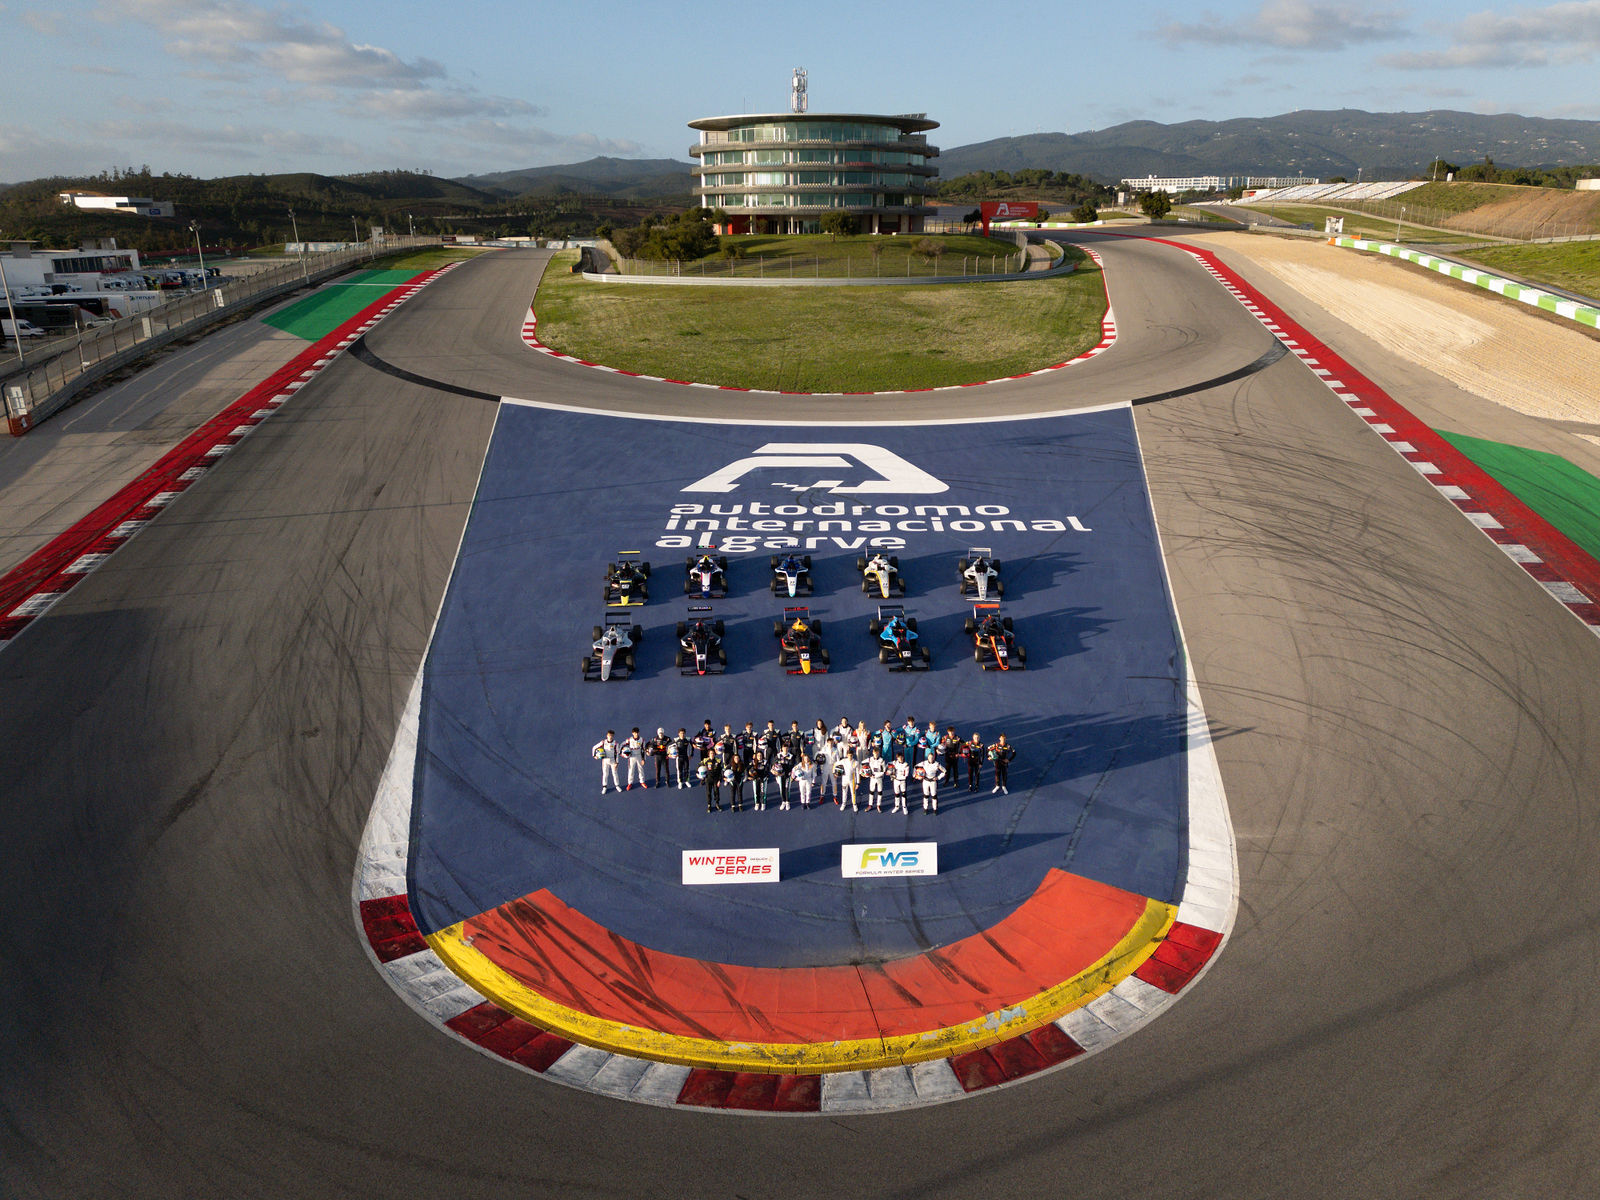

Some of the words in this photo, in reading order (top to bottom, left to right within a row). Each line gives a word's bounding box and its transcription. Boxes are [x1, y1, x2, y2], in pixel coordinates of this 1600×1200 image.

[670, 502, 1010, 516] autodromo
[665, 515, 1092, 531] internacional
[655, 531, 906, 552] algarve
[689, 856, 747, 866] WINTER
[860, 847, 919, 869] FWS
[715, 865, 772, 875] SERIES
